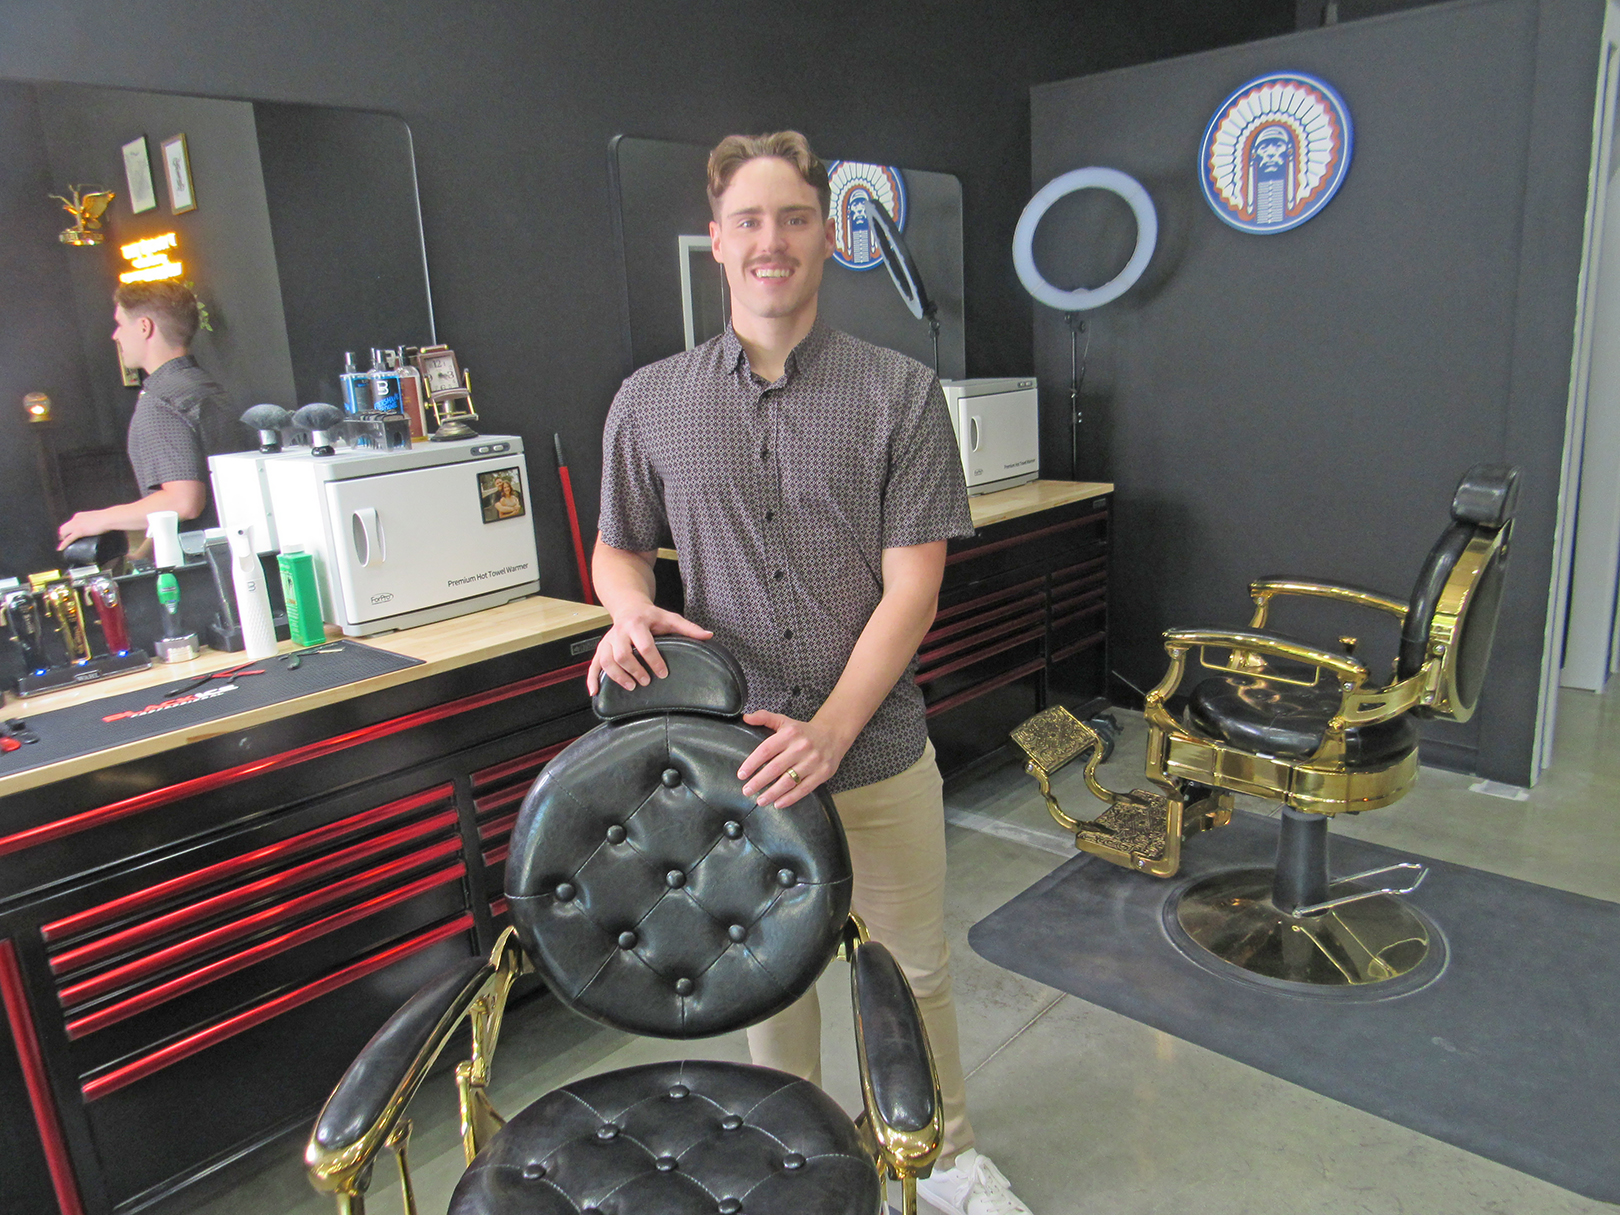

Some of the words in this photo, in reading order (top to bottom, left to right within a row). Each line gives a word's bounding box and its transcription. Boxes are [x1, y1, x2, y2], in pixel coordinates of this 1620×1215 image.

[432, 360, 442, 368] 12
[447, 370, 454, 379] 3
[447, 576, 476, 587] Premium
[476, 573, 488, 581] Hot
[487, 567, 506, 578] Towel
[506, 563, 529, 574] Warmer
